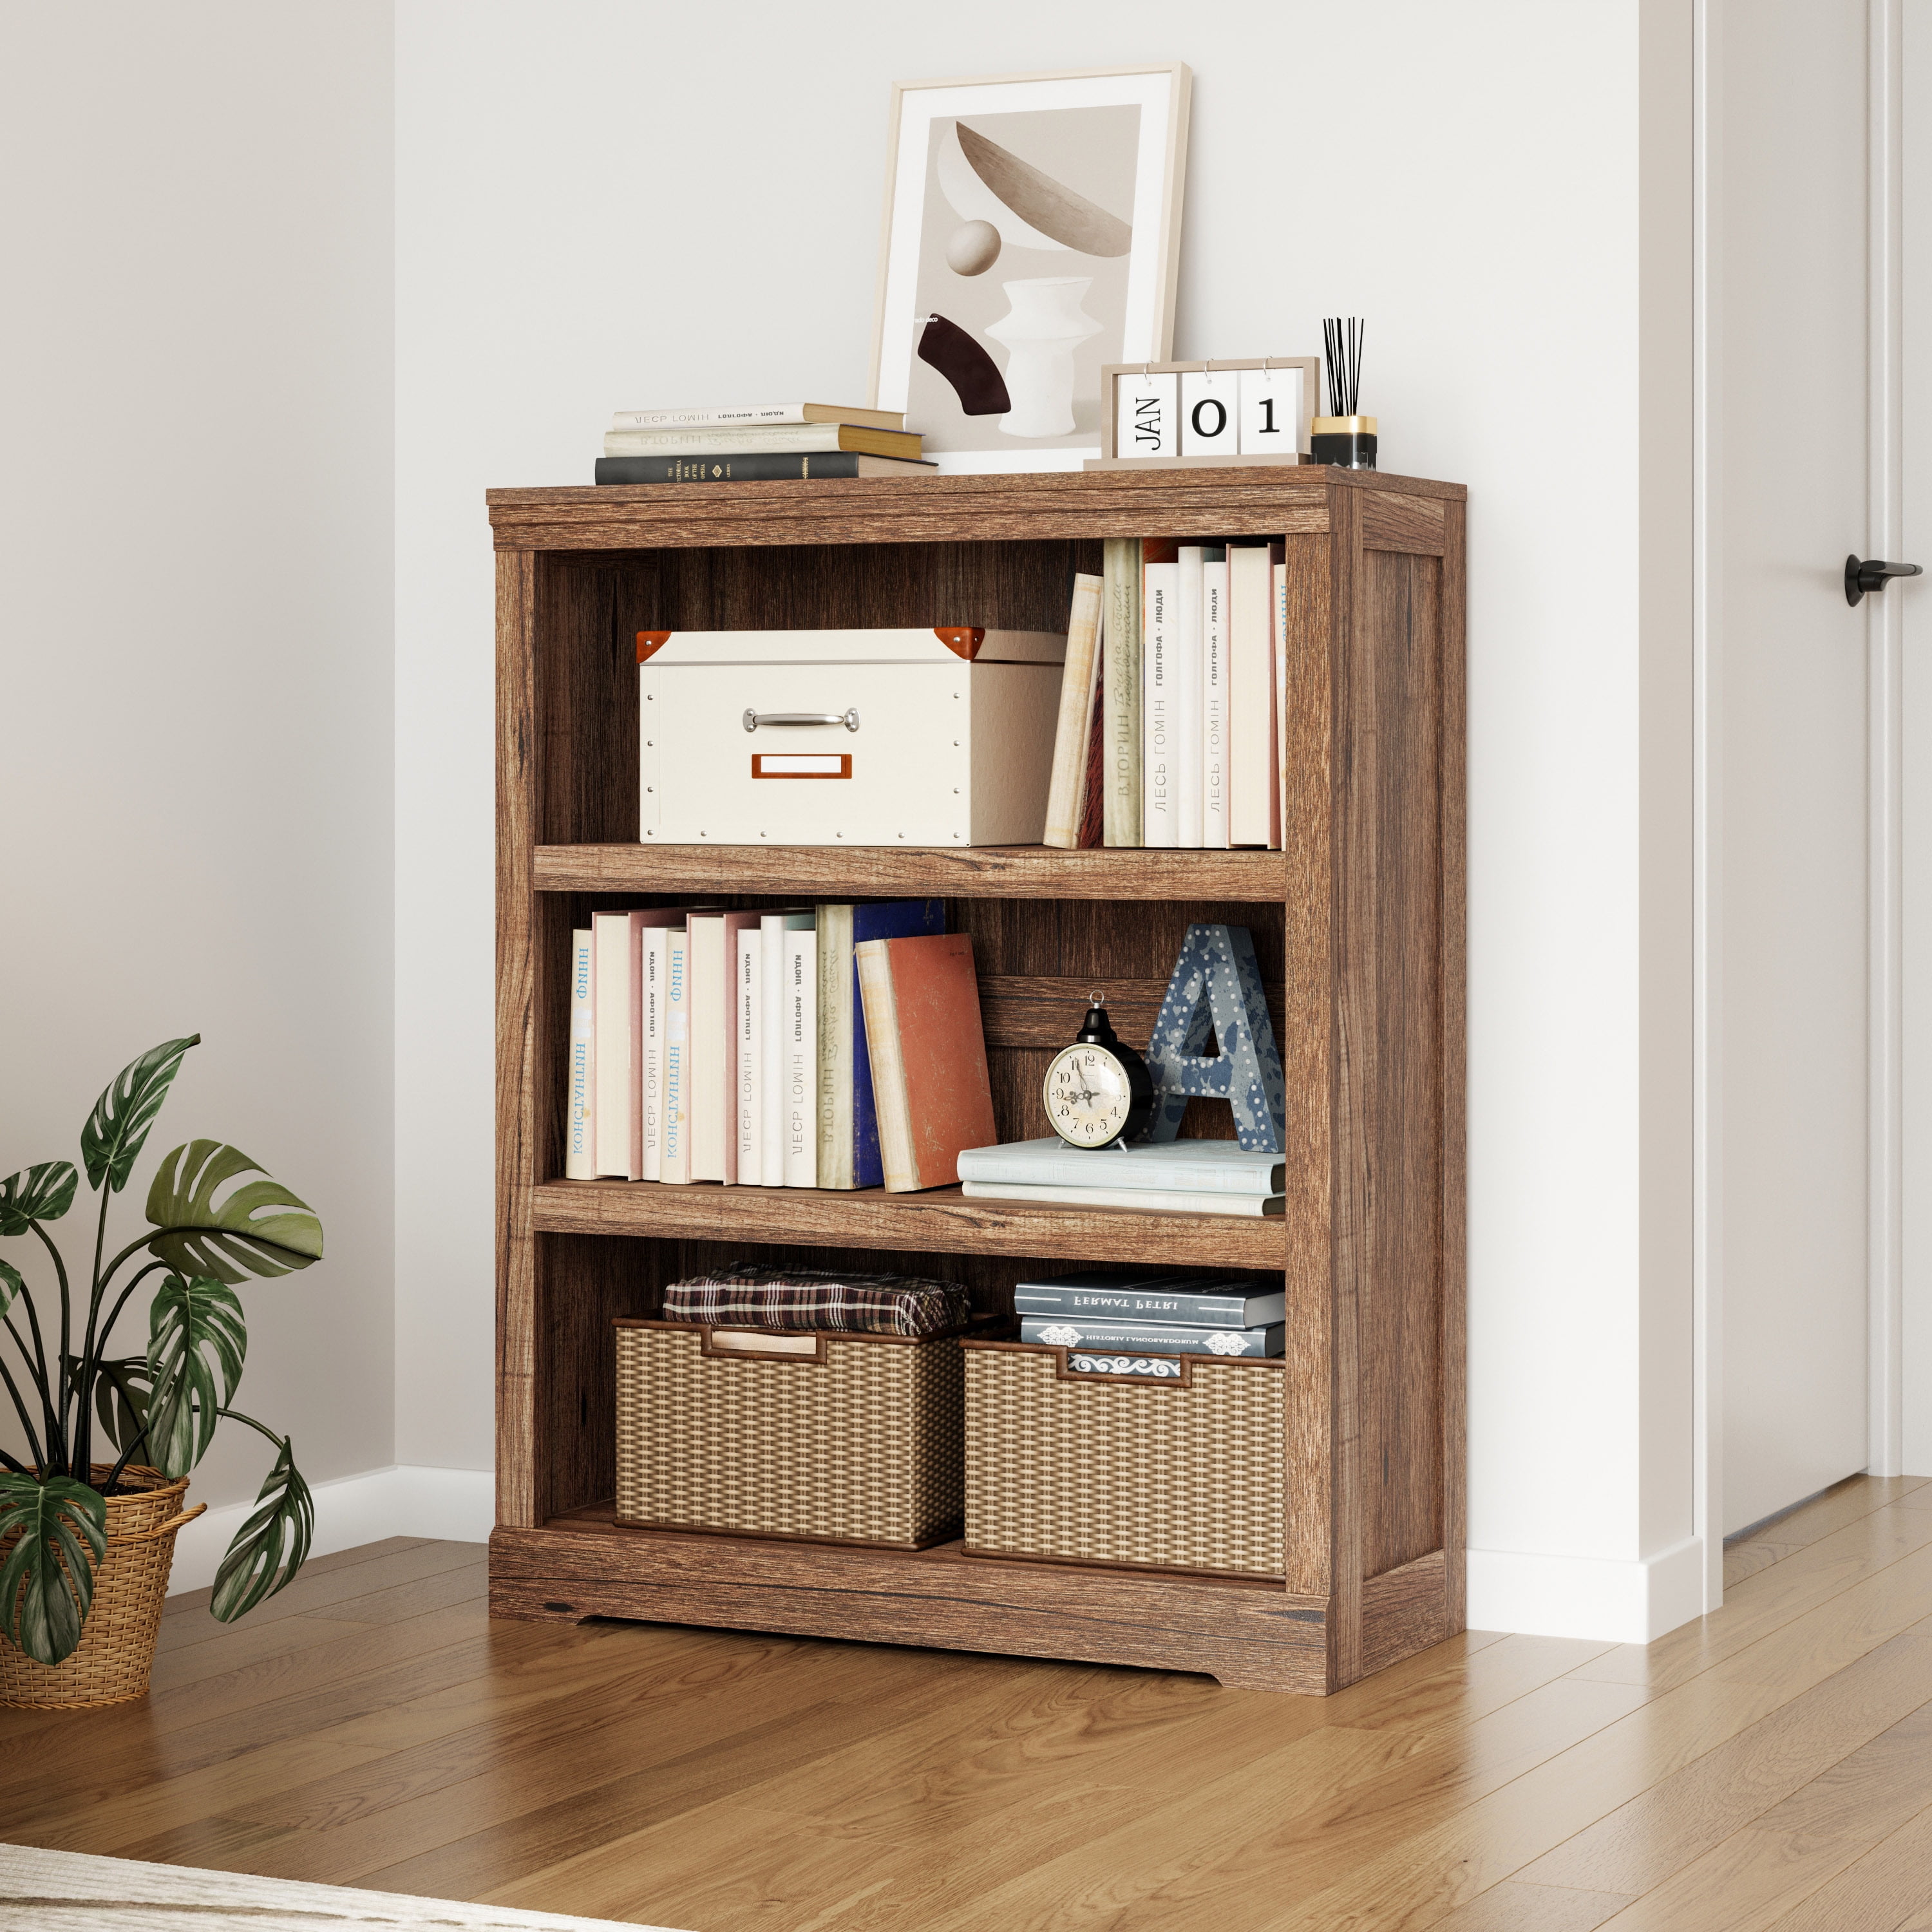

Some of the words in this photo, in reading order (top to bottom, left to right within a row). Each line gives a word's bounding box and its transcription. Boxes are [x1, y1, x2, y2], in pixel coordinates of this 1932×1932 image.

[1135, 397, 1160, 450] JAN
[1259, 399, 1280, 433] 1
[1155, 589, 1164, 623] ЛЮДИ
[1154, 700, 1165, 753] ГОМІН
[1211, 700, 1219, 754] ГОМІН
[1117, 714, 1129, 797] В.ТОРИН
[1155, 764, 1166, 812] ЛЕСЬ
[1211, 764, 1220, 813] ЛЕСЬ
[1136, 923, 1285, 1153] A
[1085, 1055, 1095, 1066] 12
[1061, 1072, 1070, 1084] 10
[1056, 1088, 1064, 1100] 9
[1061, 1104, 1070, 1116] 8
[1110, 1106, 1118, 1117] 4
[1073, 1117, 1080, 1129] 7
[1086, 1123, 1094, 1134] 6
[1099, 1119, 1108, 1130] 5
